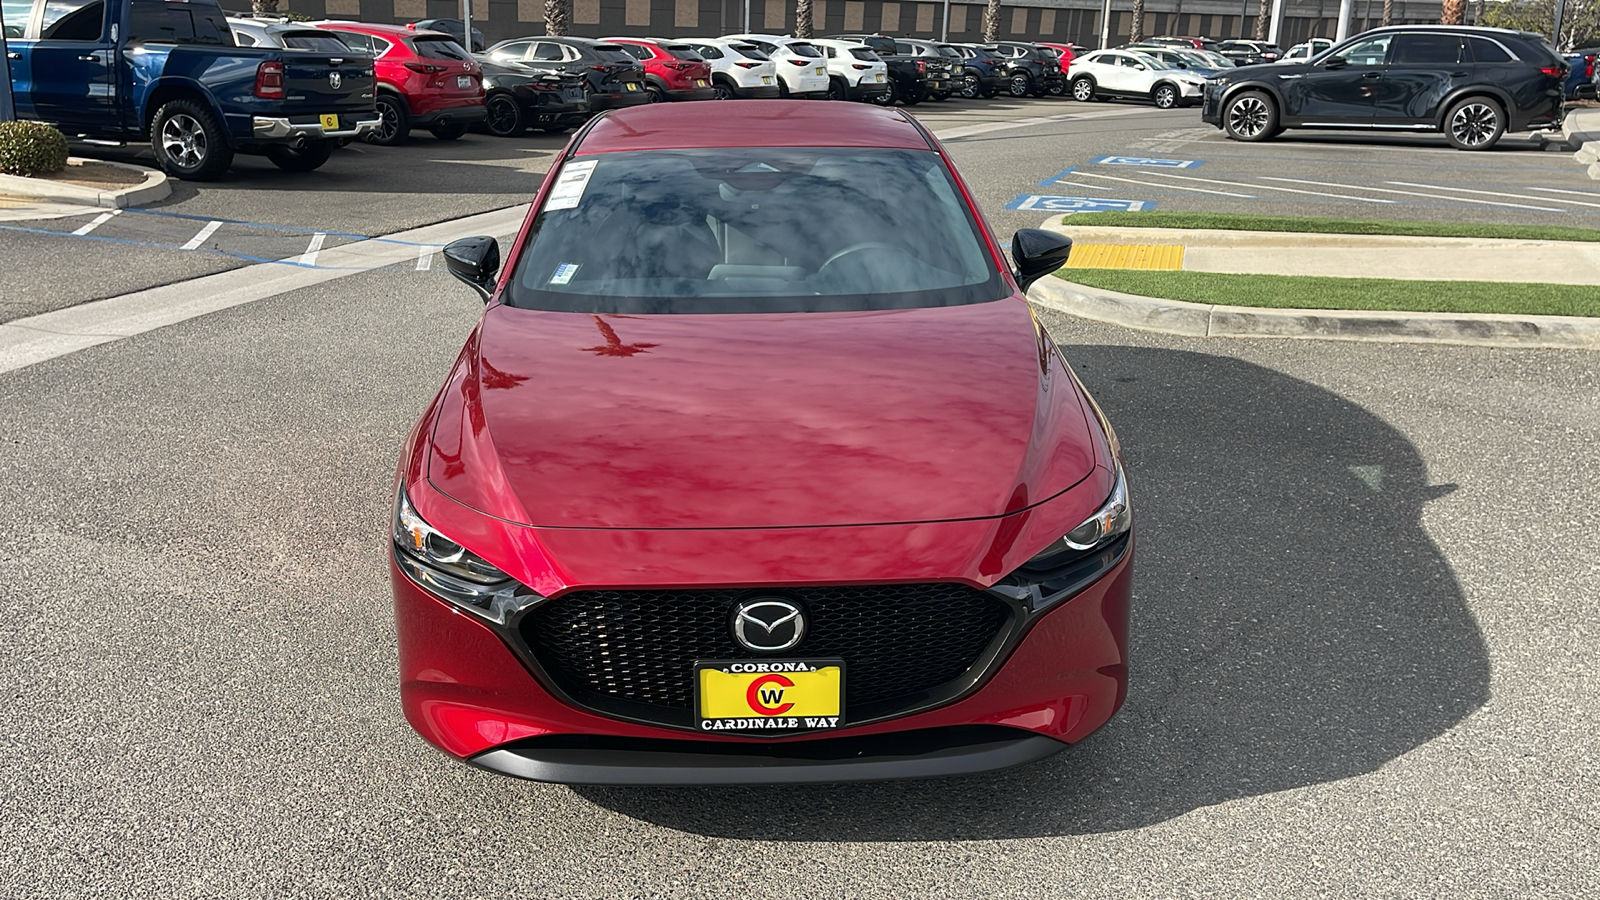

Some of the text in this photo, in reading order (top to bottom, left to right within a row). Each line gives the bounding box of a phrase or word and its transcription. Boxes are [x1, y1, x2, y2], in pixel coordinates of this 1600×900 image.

[731, 662, 809, 672] CORONA
[746, 673, 795, 716] C
[761, 689, 784, 704] W
[701, 717, 839, 730] CARDINALE WAY
